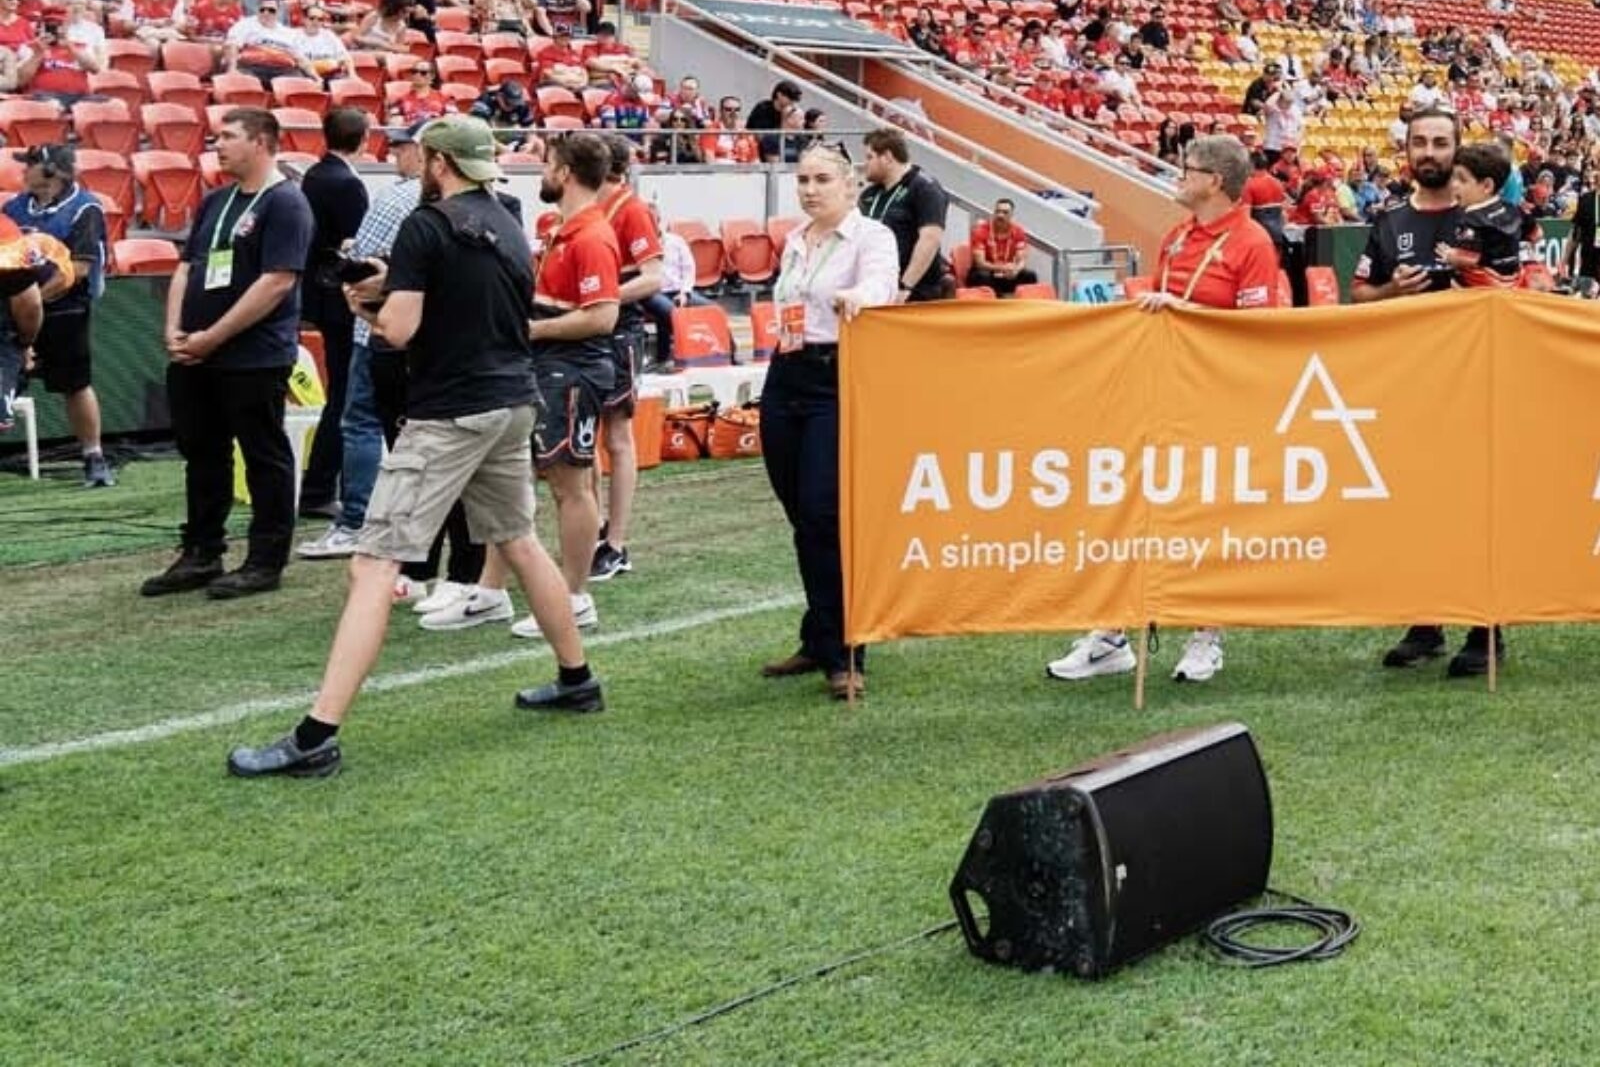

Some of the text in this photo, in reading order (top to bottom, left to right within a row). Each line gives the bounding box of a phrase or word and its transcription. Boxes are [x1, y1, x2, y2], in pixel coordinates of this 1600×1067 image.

[901, 445, 1330, 514] AUSBUILD
[901, 526, 1328, 573] A simple journey home
